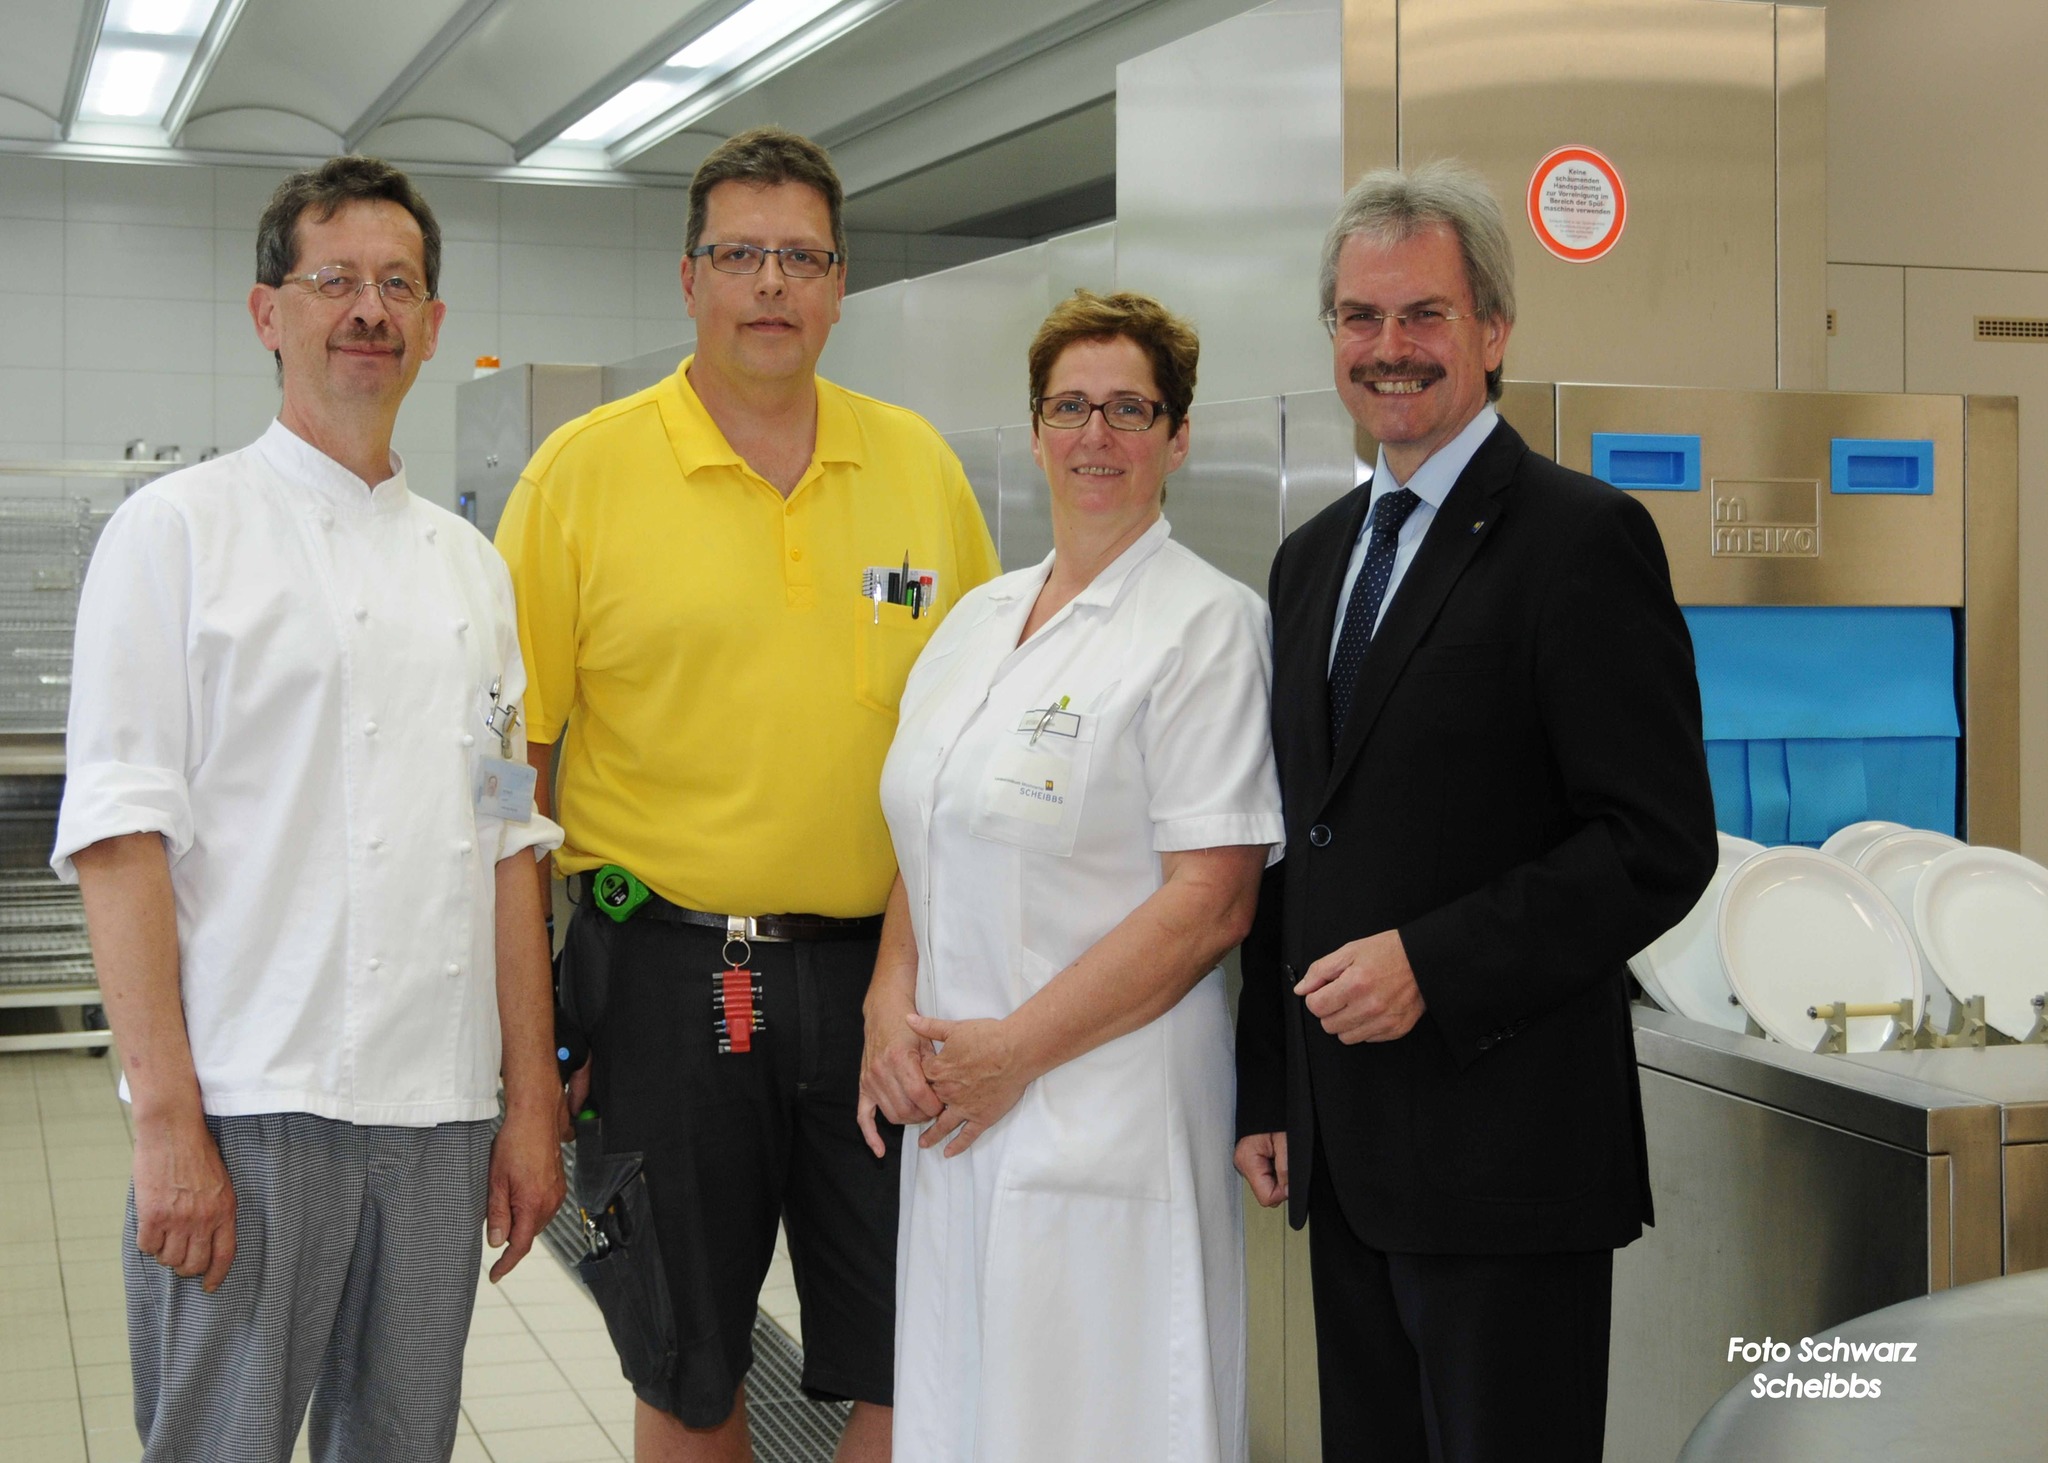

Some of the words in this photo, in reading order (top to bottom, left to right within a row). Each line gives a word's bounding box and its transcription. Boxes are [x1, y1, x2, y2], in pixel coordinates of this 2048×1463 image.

[1555, 176, 1600, 184] schäumenden
[1553, 183, 1602, 191] Handspülmittel
[1558, 191, 1599, 200] Vorreinigung
[1588, 200, 1605, 208] Spül-
[1544, 205, 1575, 213] maschine
[1576, 207, 1611, 215] verwenden
[1019, 787, 1064, 805] SCHEIBBS
